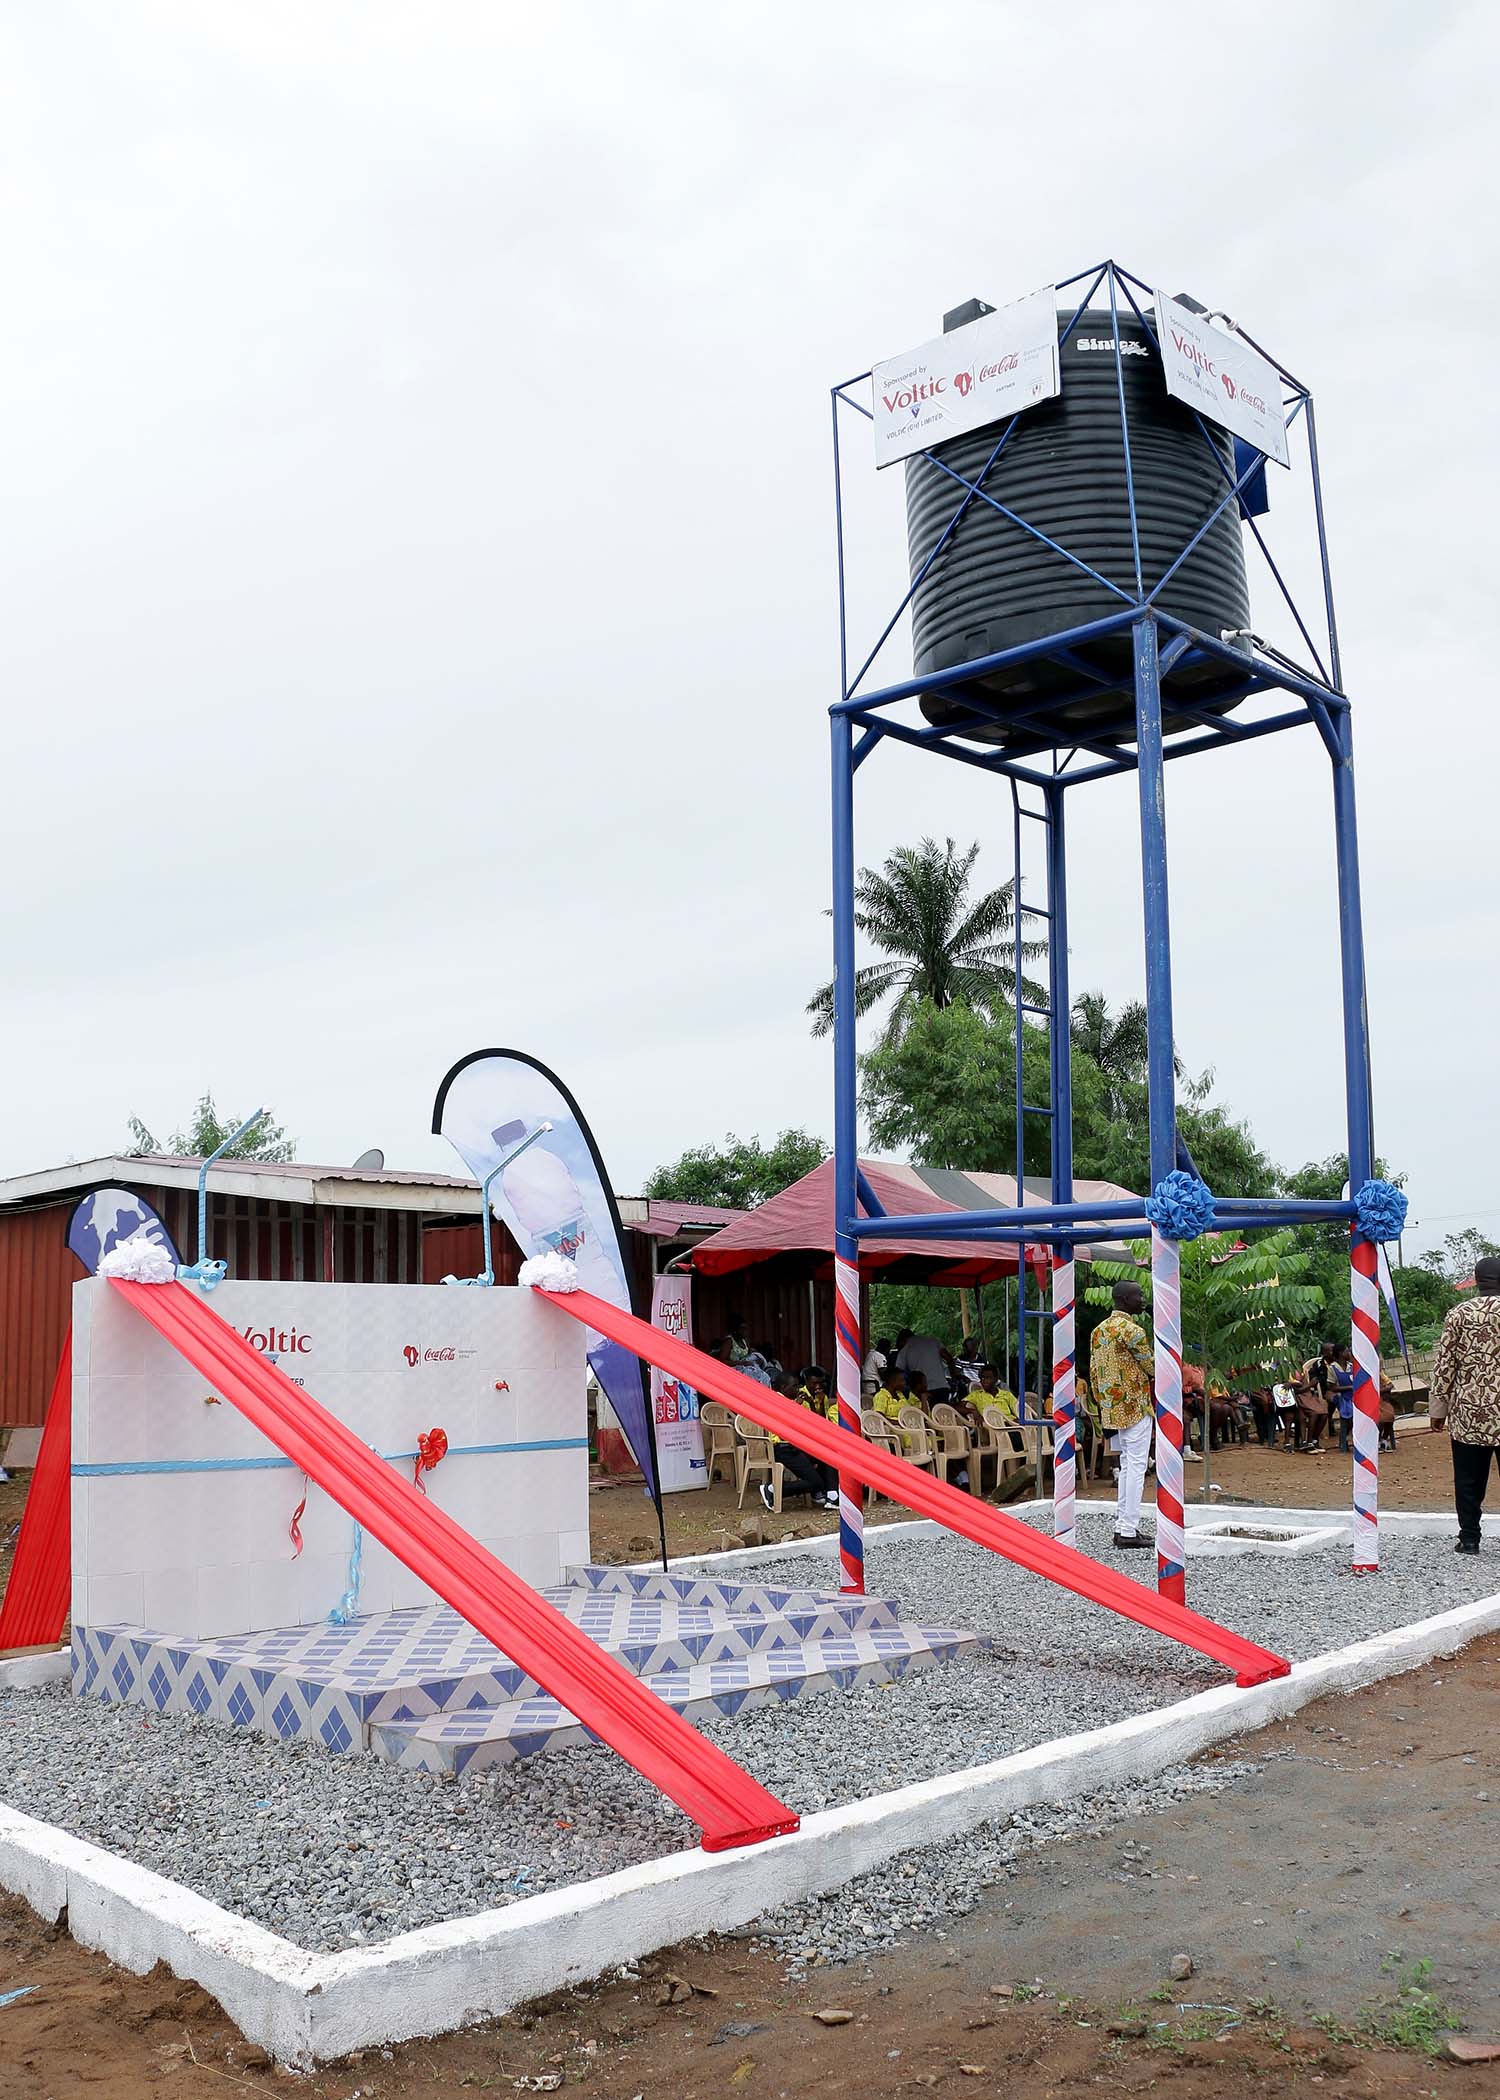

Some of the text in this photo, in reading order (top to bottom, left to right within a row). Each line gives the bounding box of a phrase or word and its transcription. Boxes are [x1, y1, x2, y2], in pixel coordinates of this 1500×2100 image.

[1170, 328, 1217, 378] Voltic
[883, 365, 928, 389] Sponsored by
[882, 375, 947, 414] Voltic
[659, 1298, 682, 1318] Level
